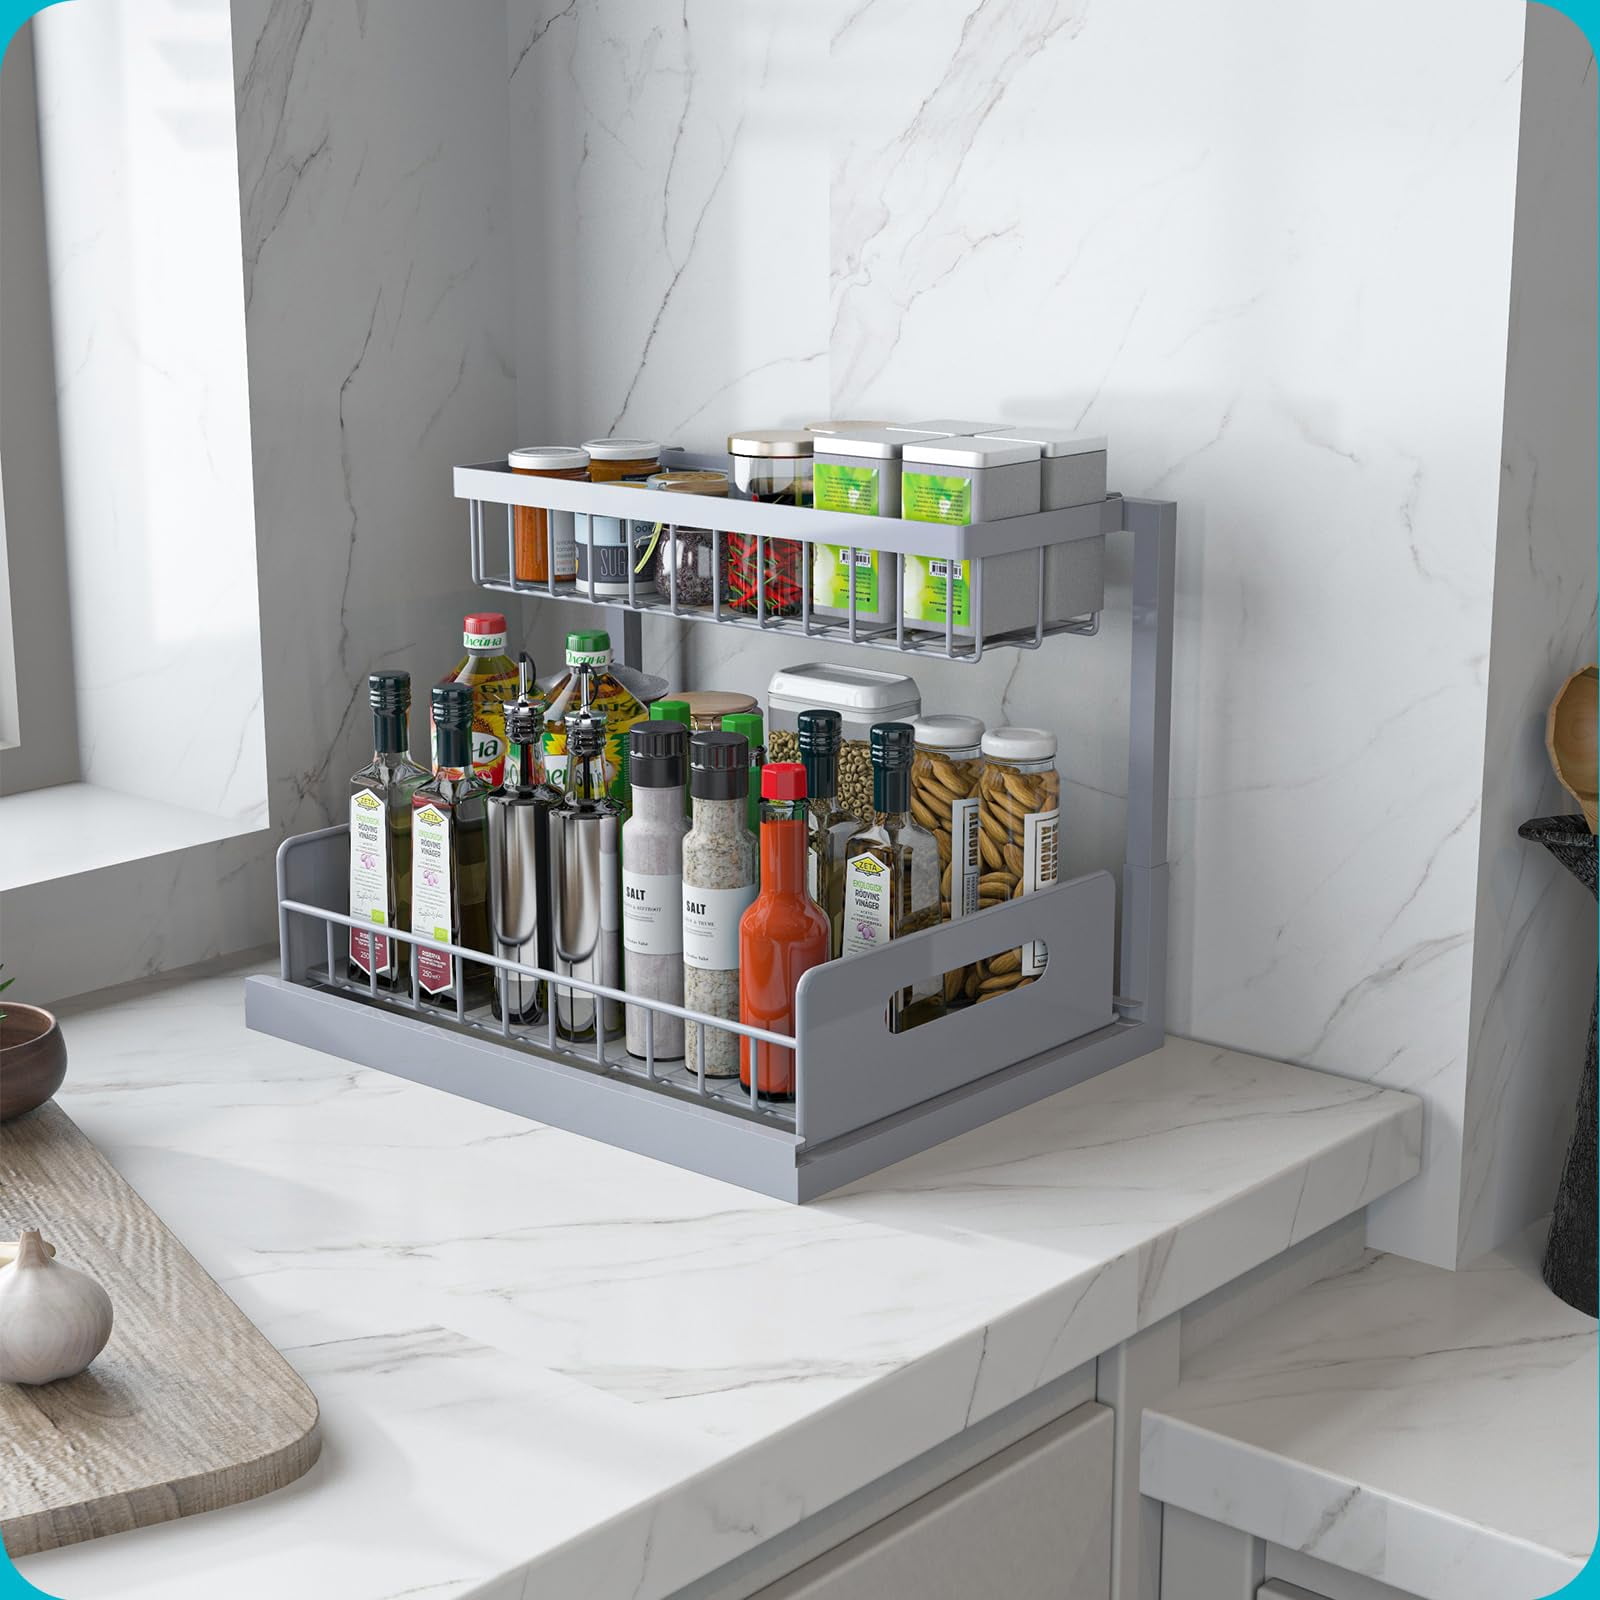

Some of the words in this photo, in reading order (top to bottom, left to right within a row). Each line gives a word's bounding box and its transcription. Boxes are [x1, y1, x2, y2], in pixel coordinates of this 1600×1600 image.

[600, 547, 628, 577] SUG
[360, 797, 375, 806] ZETA
[423, 812, 438, 822] ZETA
[969, 812, 978, 867] ALMOND
[1041, 826, 1052, 882] ALMOND
[859, 861, 877, 871] ZETA
[626, 886, 646, 901] SALT
[686, 900, 706, 915] SALT
